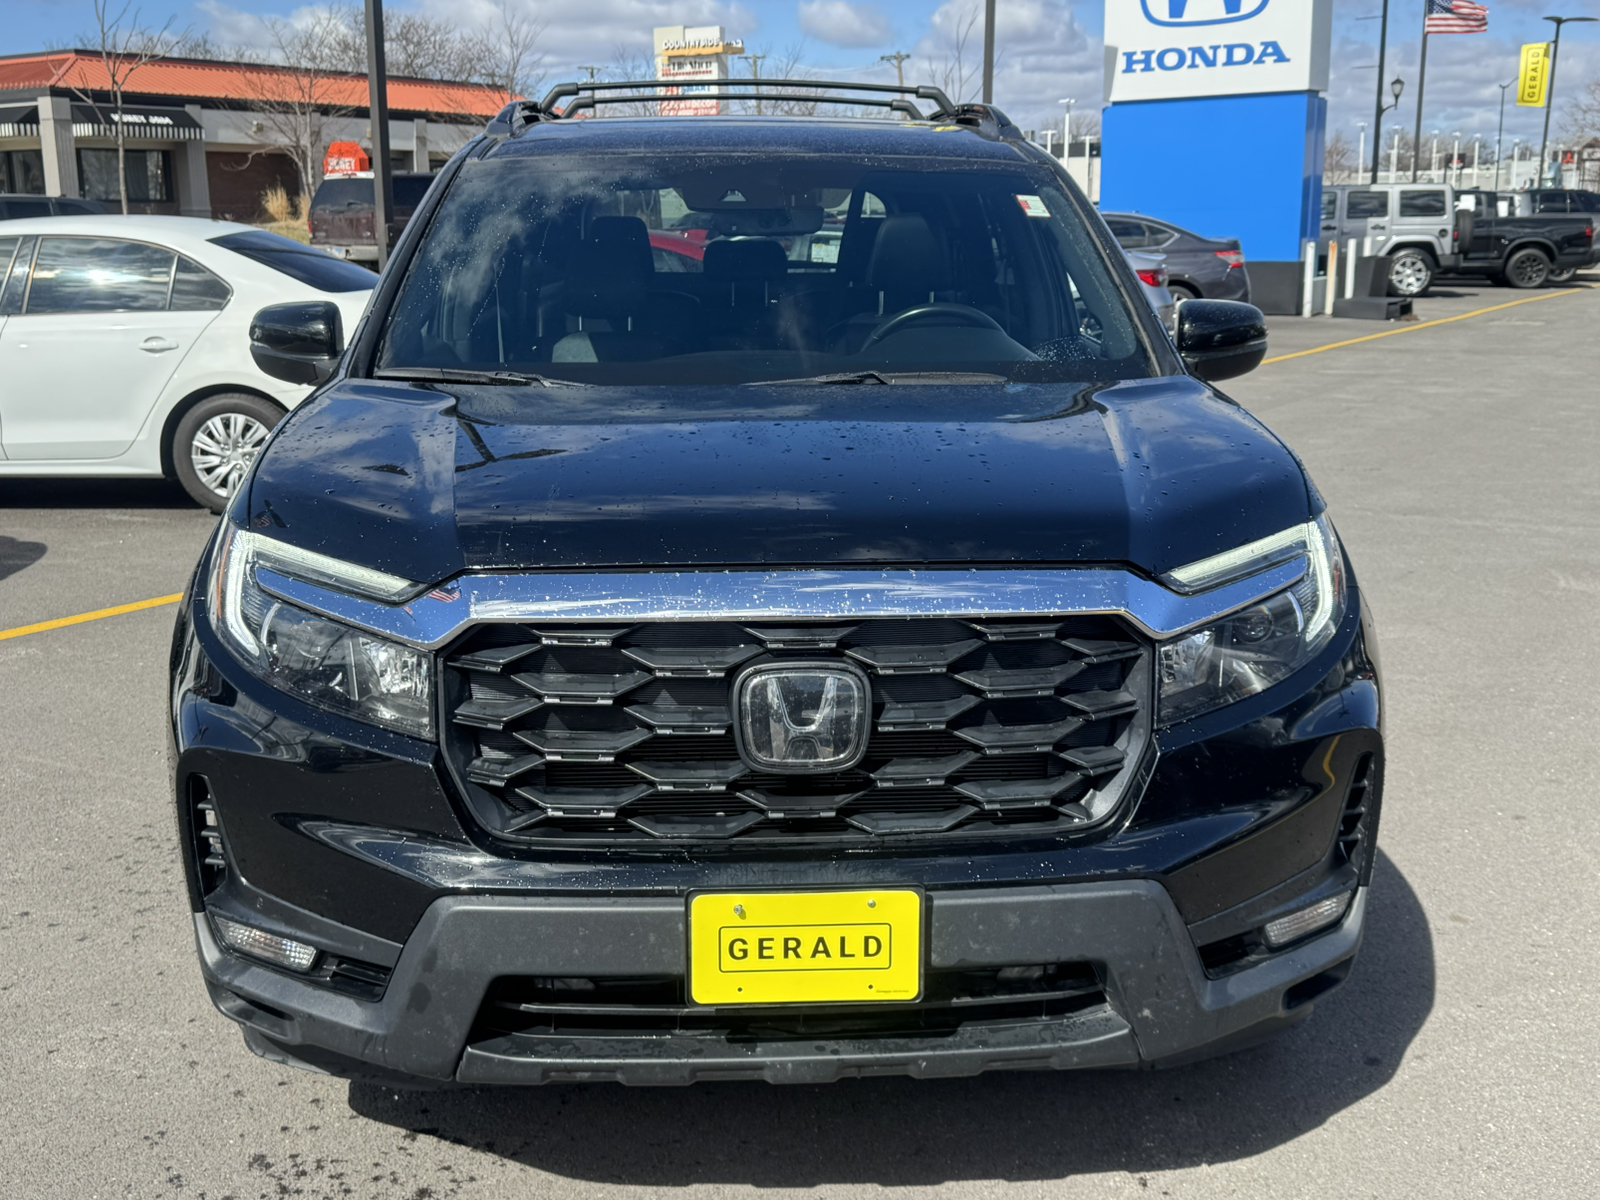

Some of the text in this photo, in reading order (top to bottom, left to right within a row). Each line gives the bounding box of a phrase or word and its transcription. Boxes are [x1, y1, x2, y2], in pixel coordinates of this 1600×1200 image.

[662, 38, 721, 51] COUNTRYSIDE
[1122, 41, 1291, 74] HONDA
[1527, 52, 1540, 99] GERALD
[728, 935, 882, 960] GERALD
